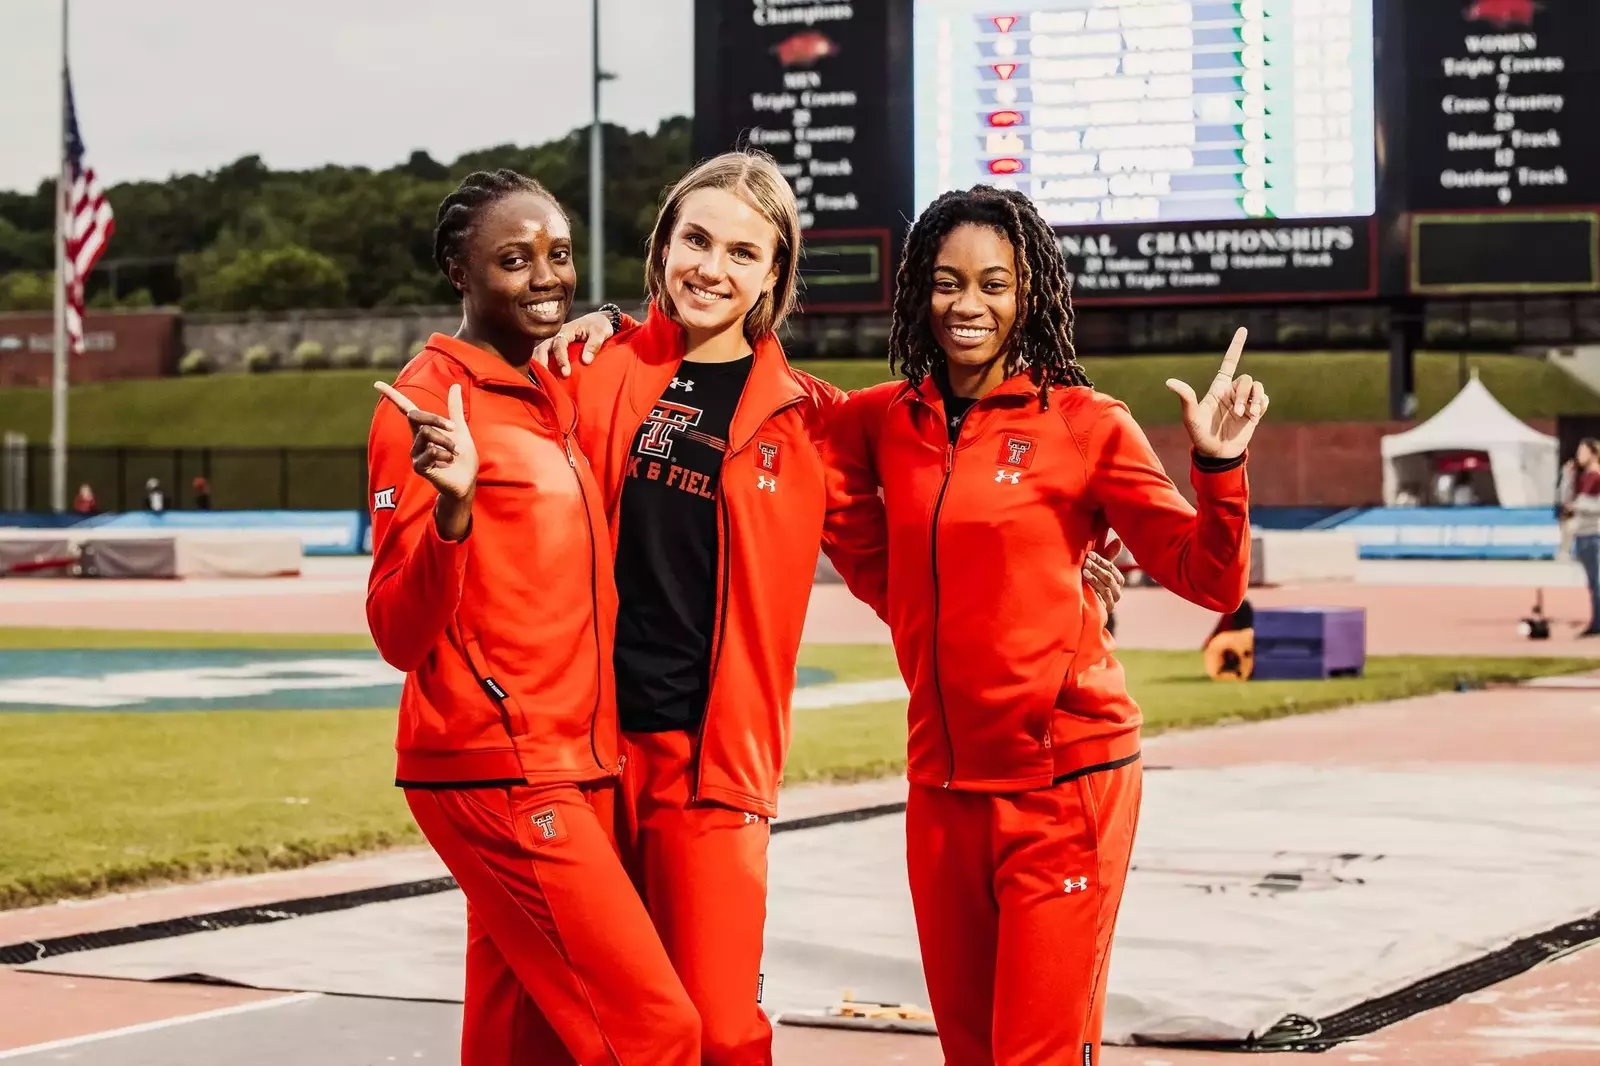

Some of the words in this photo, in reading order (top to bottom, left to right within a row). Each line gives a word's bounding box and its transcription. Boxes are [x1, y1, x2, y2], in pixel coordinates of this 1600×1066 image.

[1138, 226, 1353, 256] CHAMPIONSHIPS
[647, 462, 661, 480] &
[666, 464, 715, 500] FIEL
